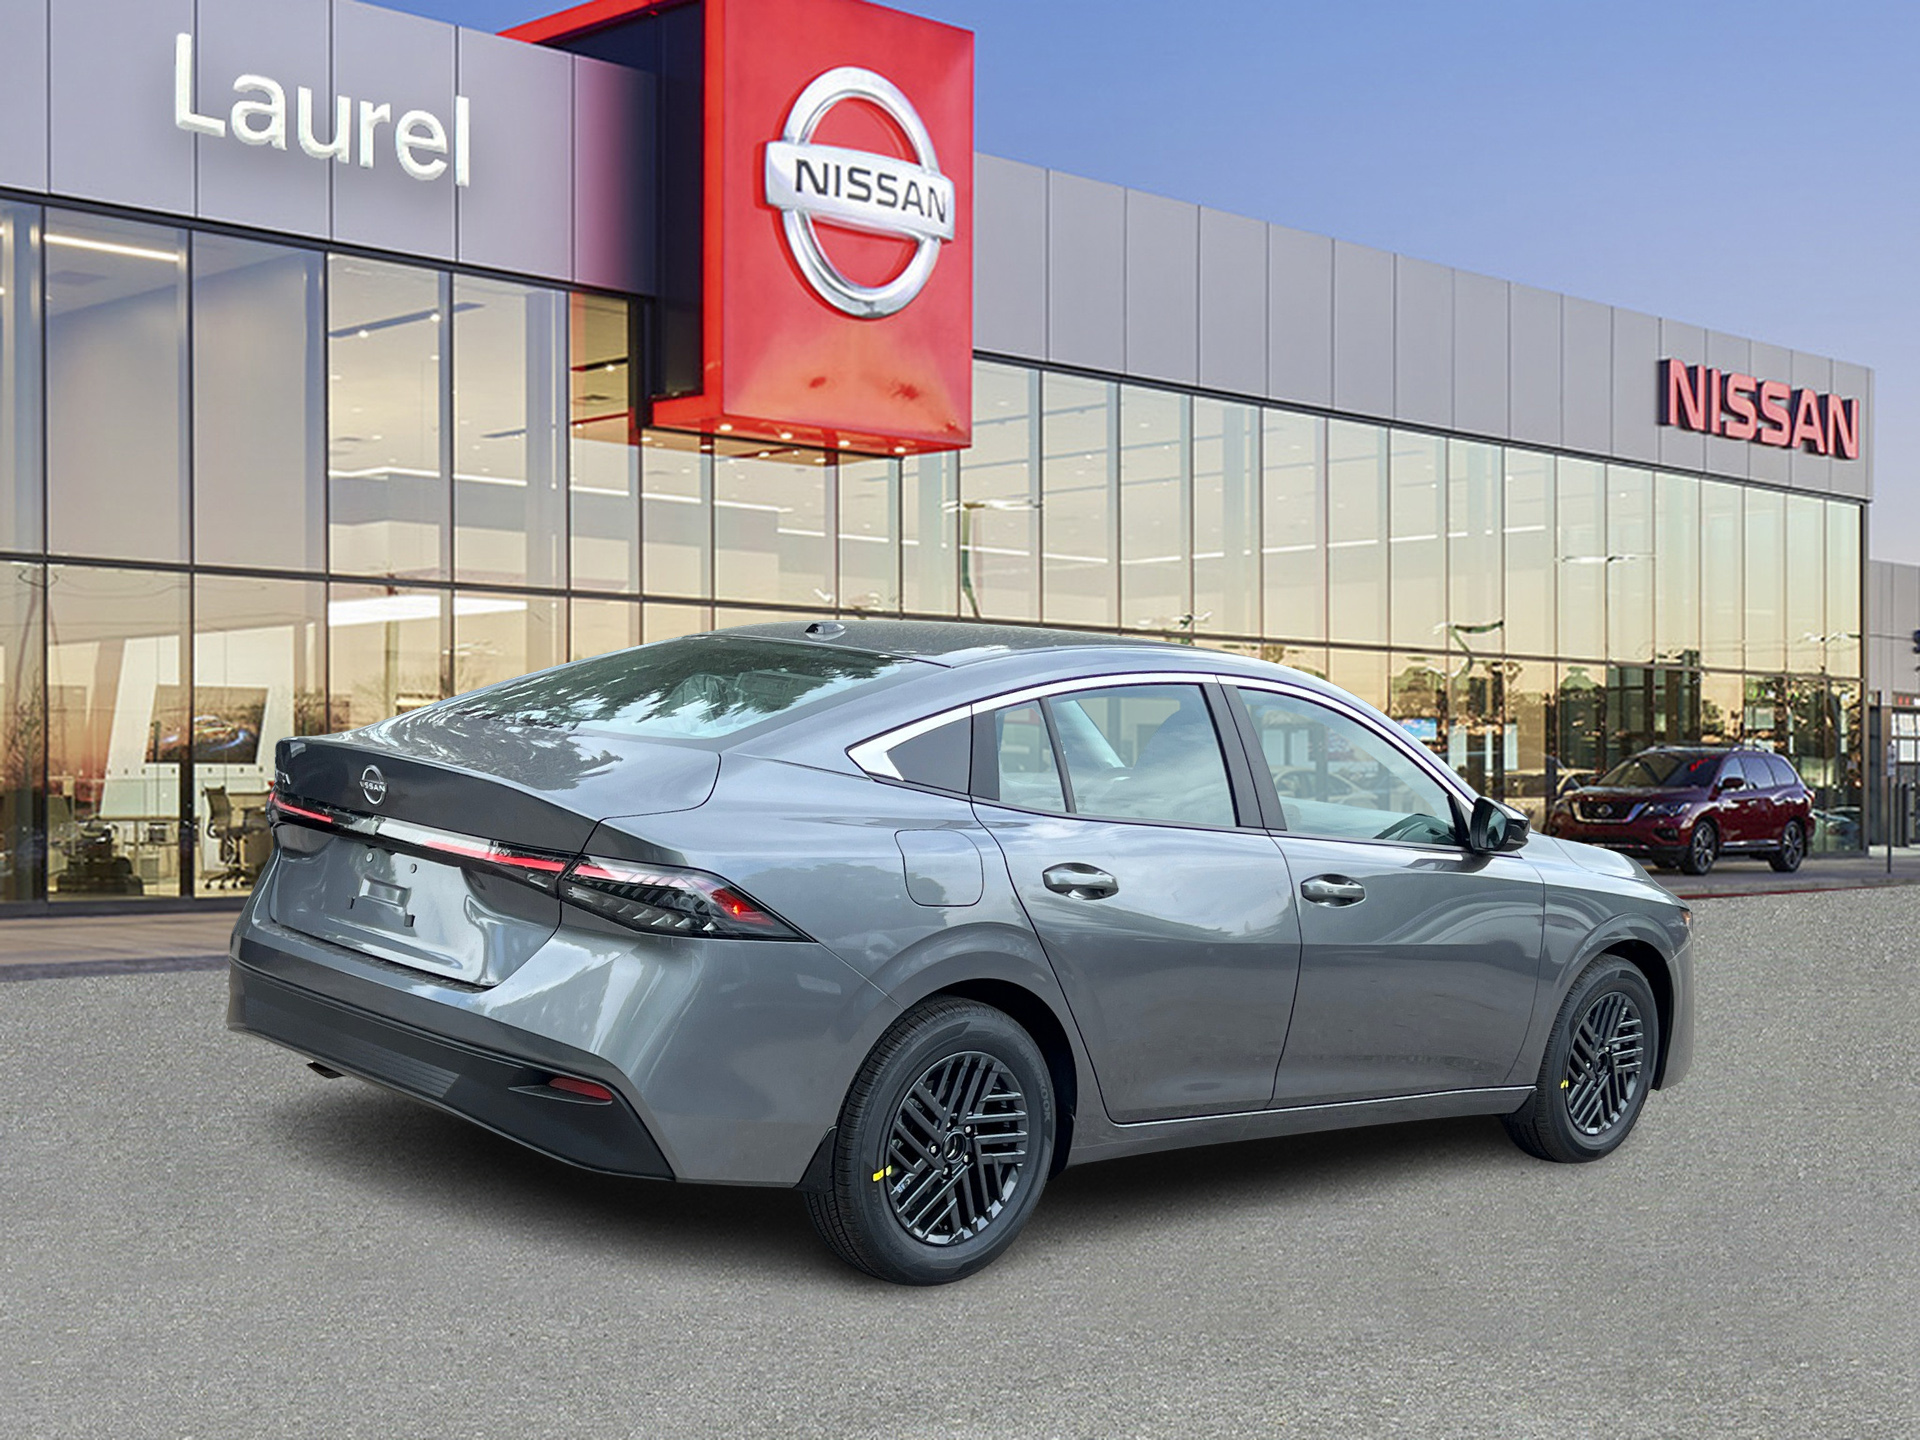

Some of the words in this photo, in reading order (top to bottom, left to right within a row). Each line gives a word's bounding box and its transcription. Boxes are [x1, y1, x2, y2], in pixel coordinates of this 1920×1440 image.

[175, 32, 470, 187] Laurel
[794, 158, 947, 224] NISSAN
[1662, 358, 1860, 460] NISSAN
